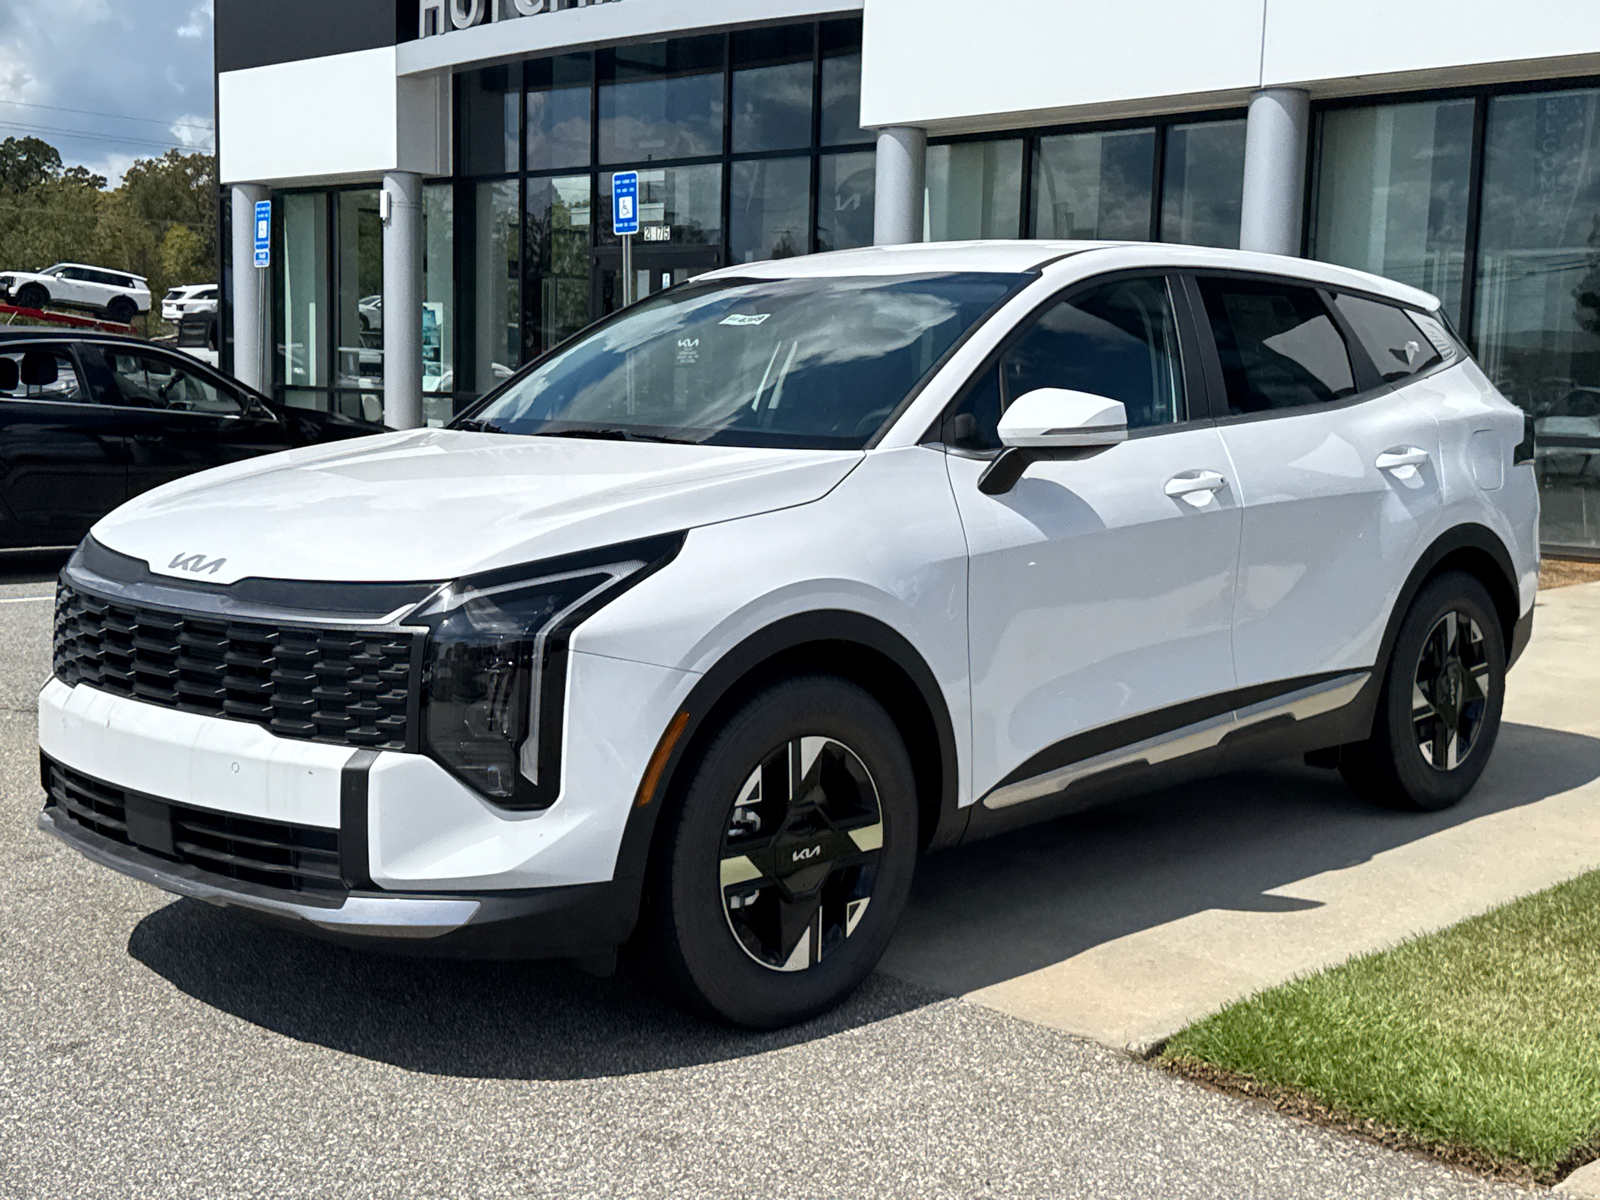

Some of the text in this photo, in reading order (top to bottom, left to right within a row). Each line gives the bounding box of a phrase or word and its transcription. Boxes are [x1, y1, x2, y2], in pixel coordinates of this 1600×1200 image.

[678, 338, 699, 347] KIA
[168, 552, 227, 574] KIA
[793, 845, 821, 862] KIA
